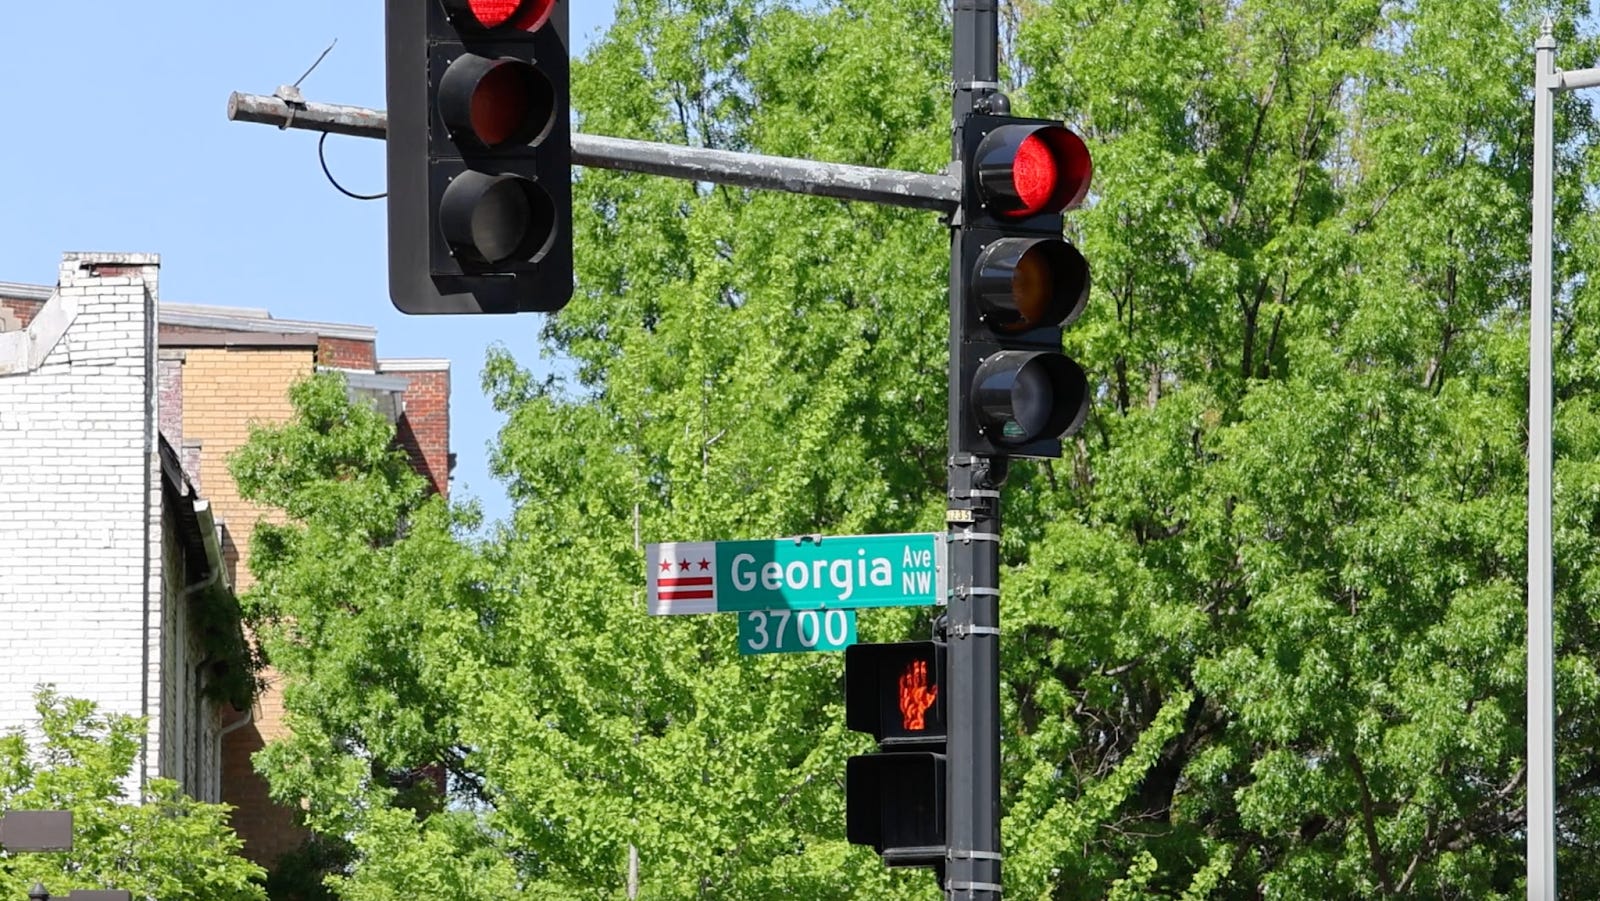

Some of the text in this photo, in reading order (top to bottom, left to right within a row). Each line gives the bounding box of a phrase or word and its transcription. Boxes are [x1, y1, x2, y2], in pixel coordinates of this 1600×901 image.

[731, 545, 932, 600] Georgia Ave
[902, 572, 931, 595] NW
[748, 610, 848, 650] 3700
